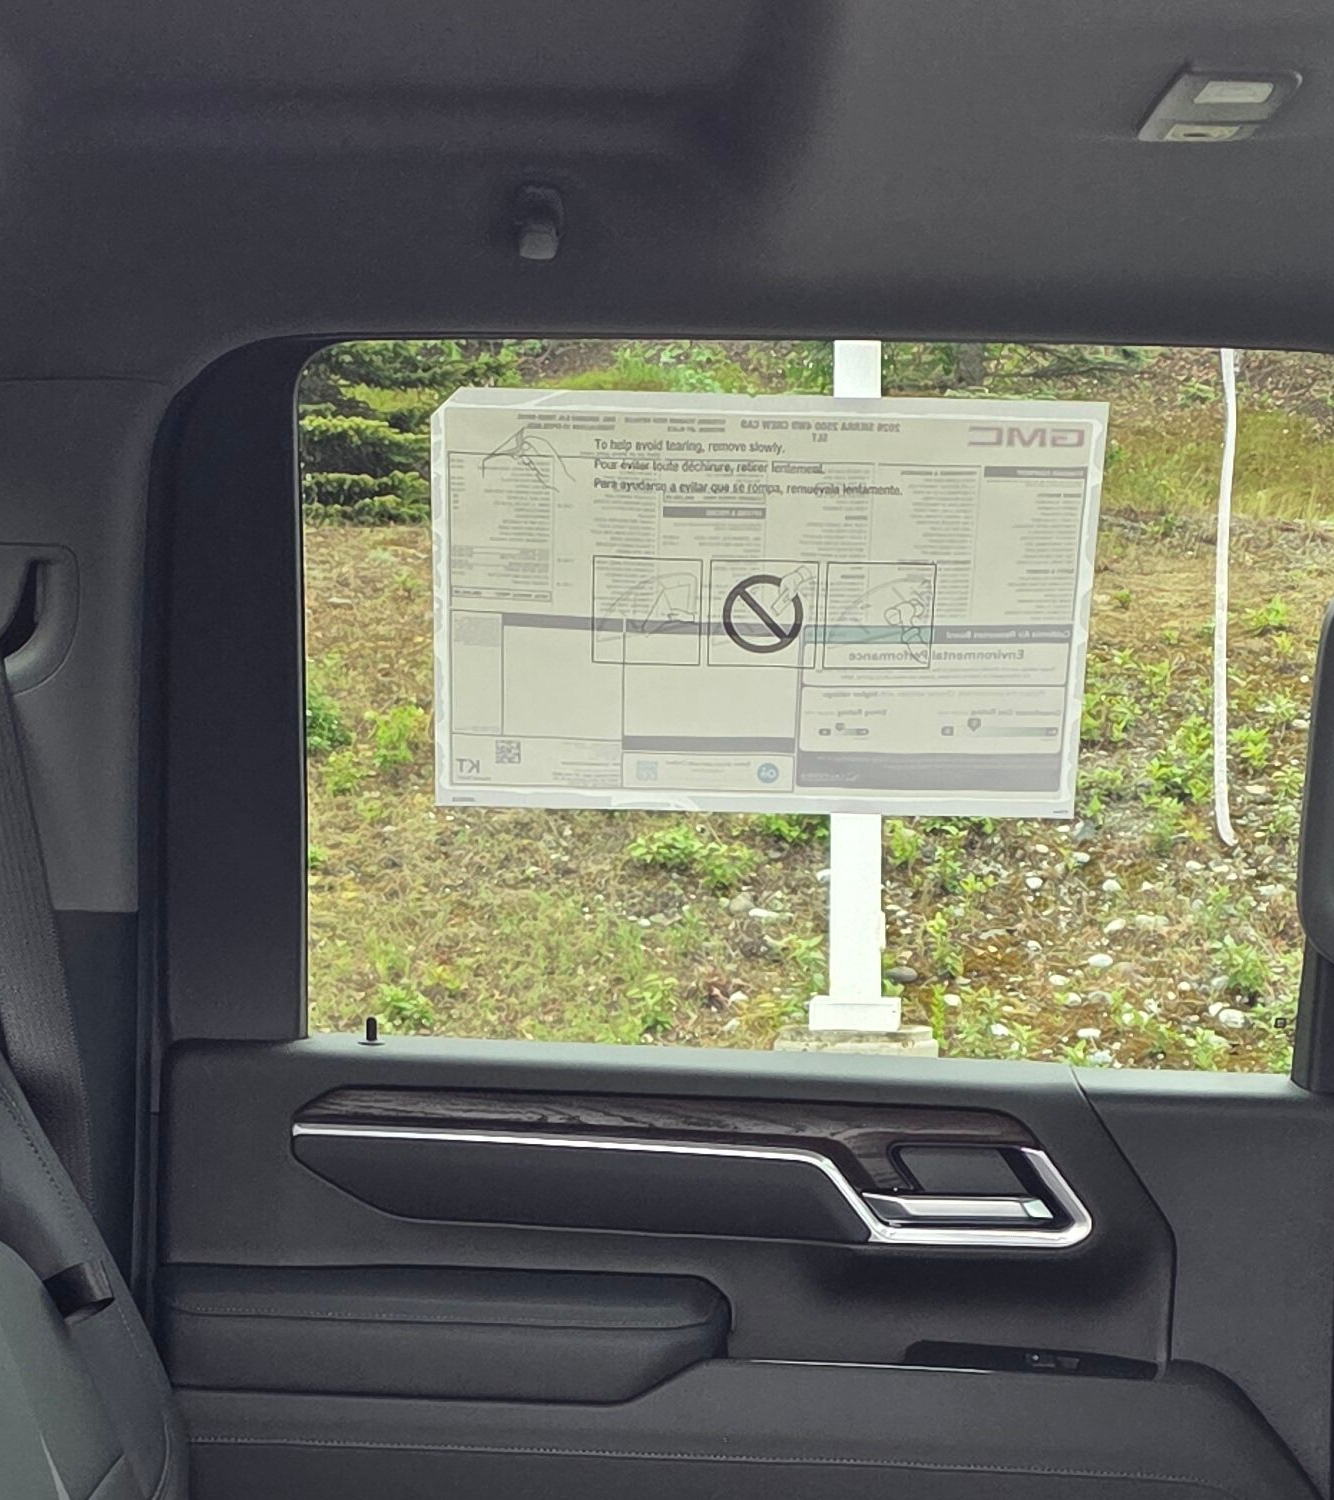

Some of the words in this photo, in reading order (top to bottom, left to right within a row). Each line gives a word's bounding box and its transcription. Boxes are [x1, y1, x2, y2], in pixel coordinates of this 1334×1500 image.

[594, 438, 608, 450] To
[610, 439, 633, 452] help
[635, 440, 663, 451] avoid
[708, 443, 747, 452] remove
[594, 458, 617, 469] Pour
[652, 460, 679, 472] toute
[593, 477, 618, 490] Para
[669, 483, 677, 493] a
[679, 481, 708, 493] evitar
[710, 483, 730, 494] que
[732, 484, 745, 493] se
